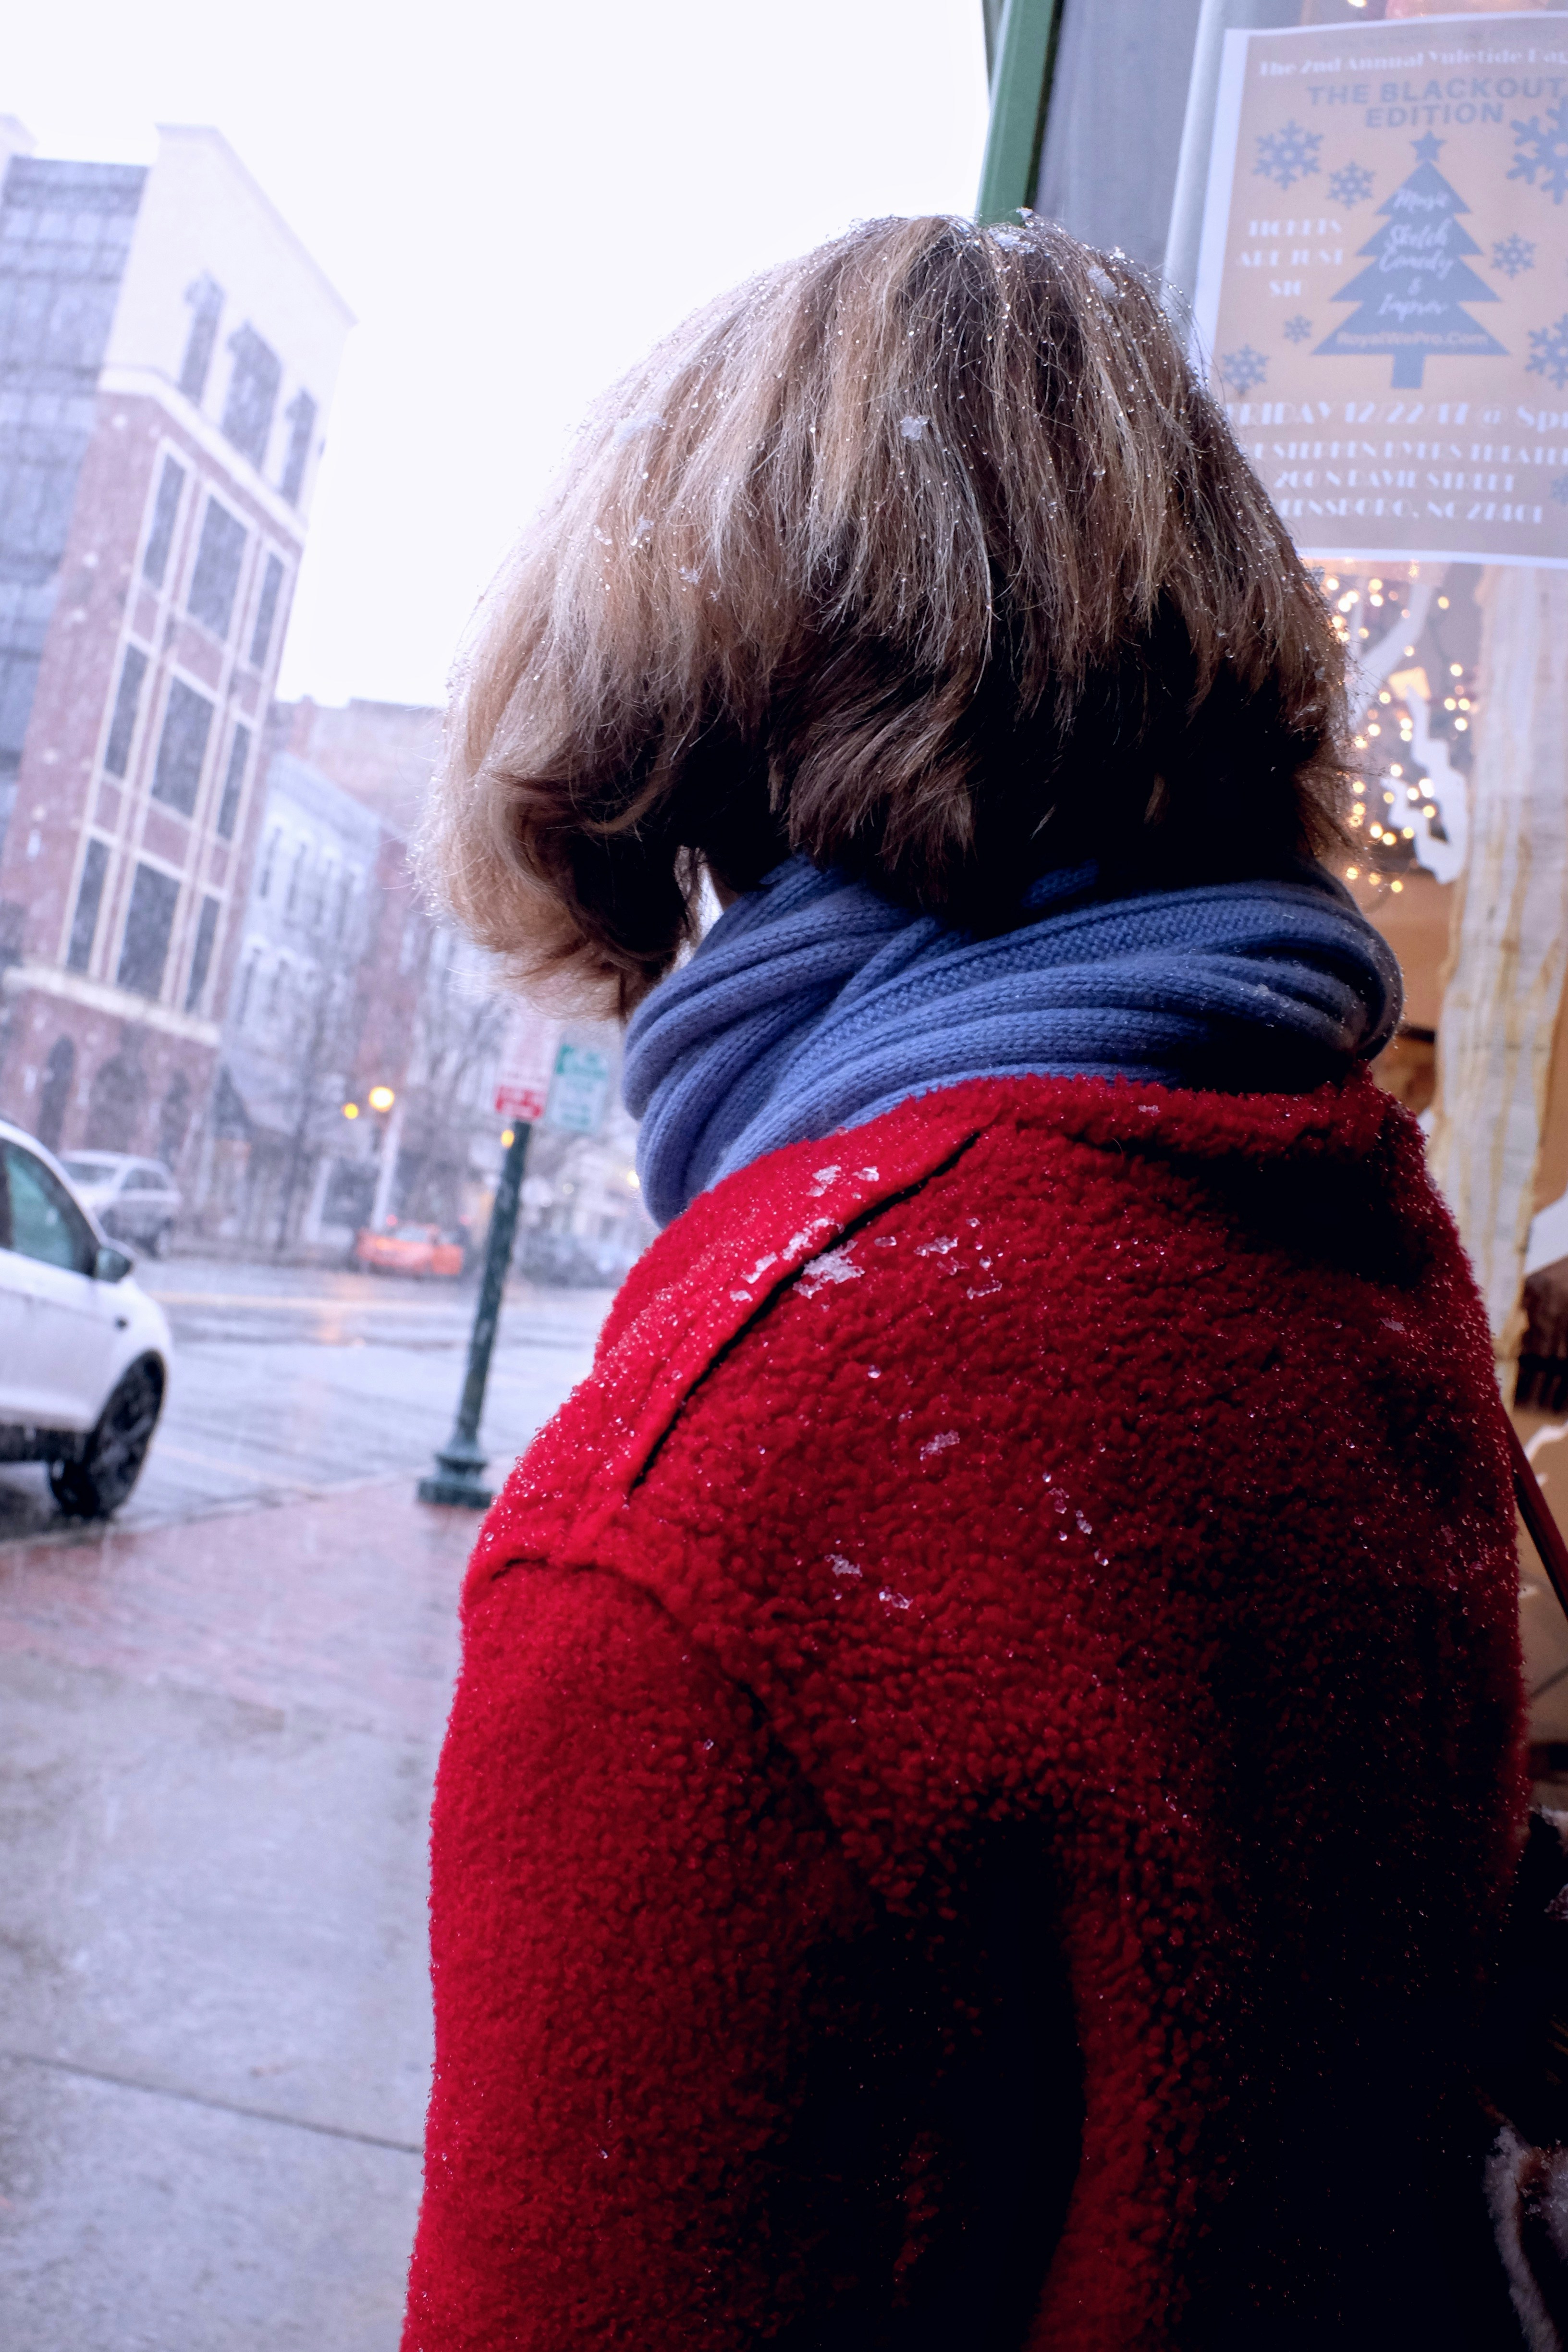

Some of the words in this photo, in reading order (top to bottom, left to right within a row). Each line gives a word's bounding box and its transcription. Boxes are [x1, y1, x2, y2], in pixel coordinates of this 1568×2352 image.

[1260, 61, 1296, 76] The
[1300, 57, 1341, 74] 2nd
[1344, 52, 1424, 71] Annual
[1428, 48, 1522, 65] Yuletide
[1307, 83, 1370, 105] THE
[1380, 77, 1567, 103] BLACKOUT
[1365, 102, 1504, 128] EDITION
[1345, 401, 1470, 425] 12/22/17
